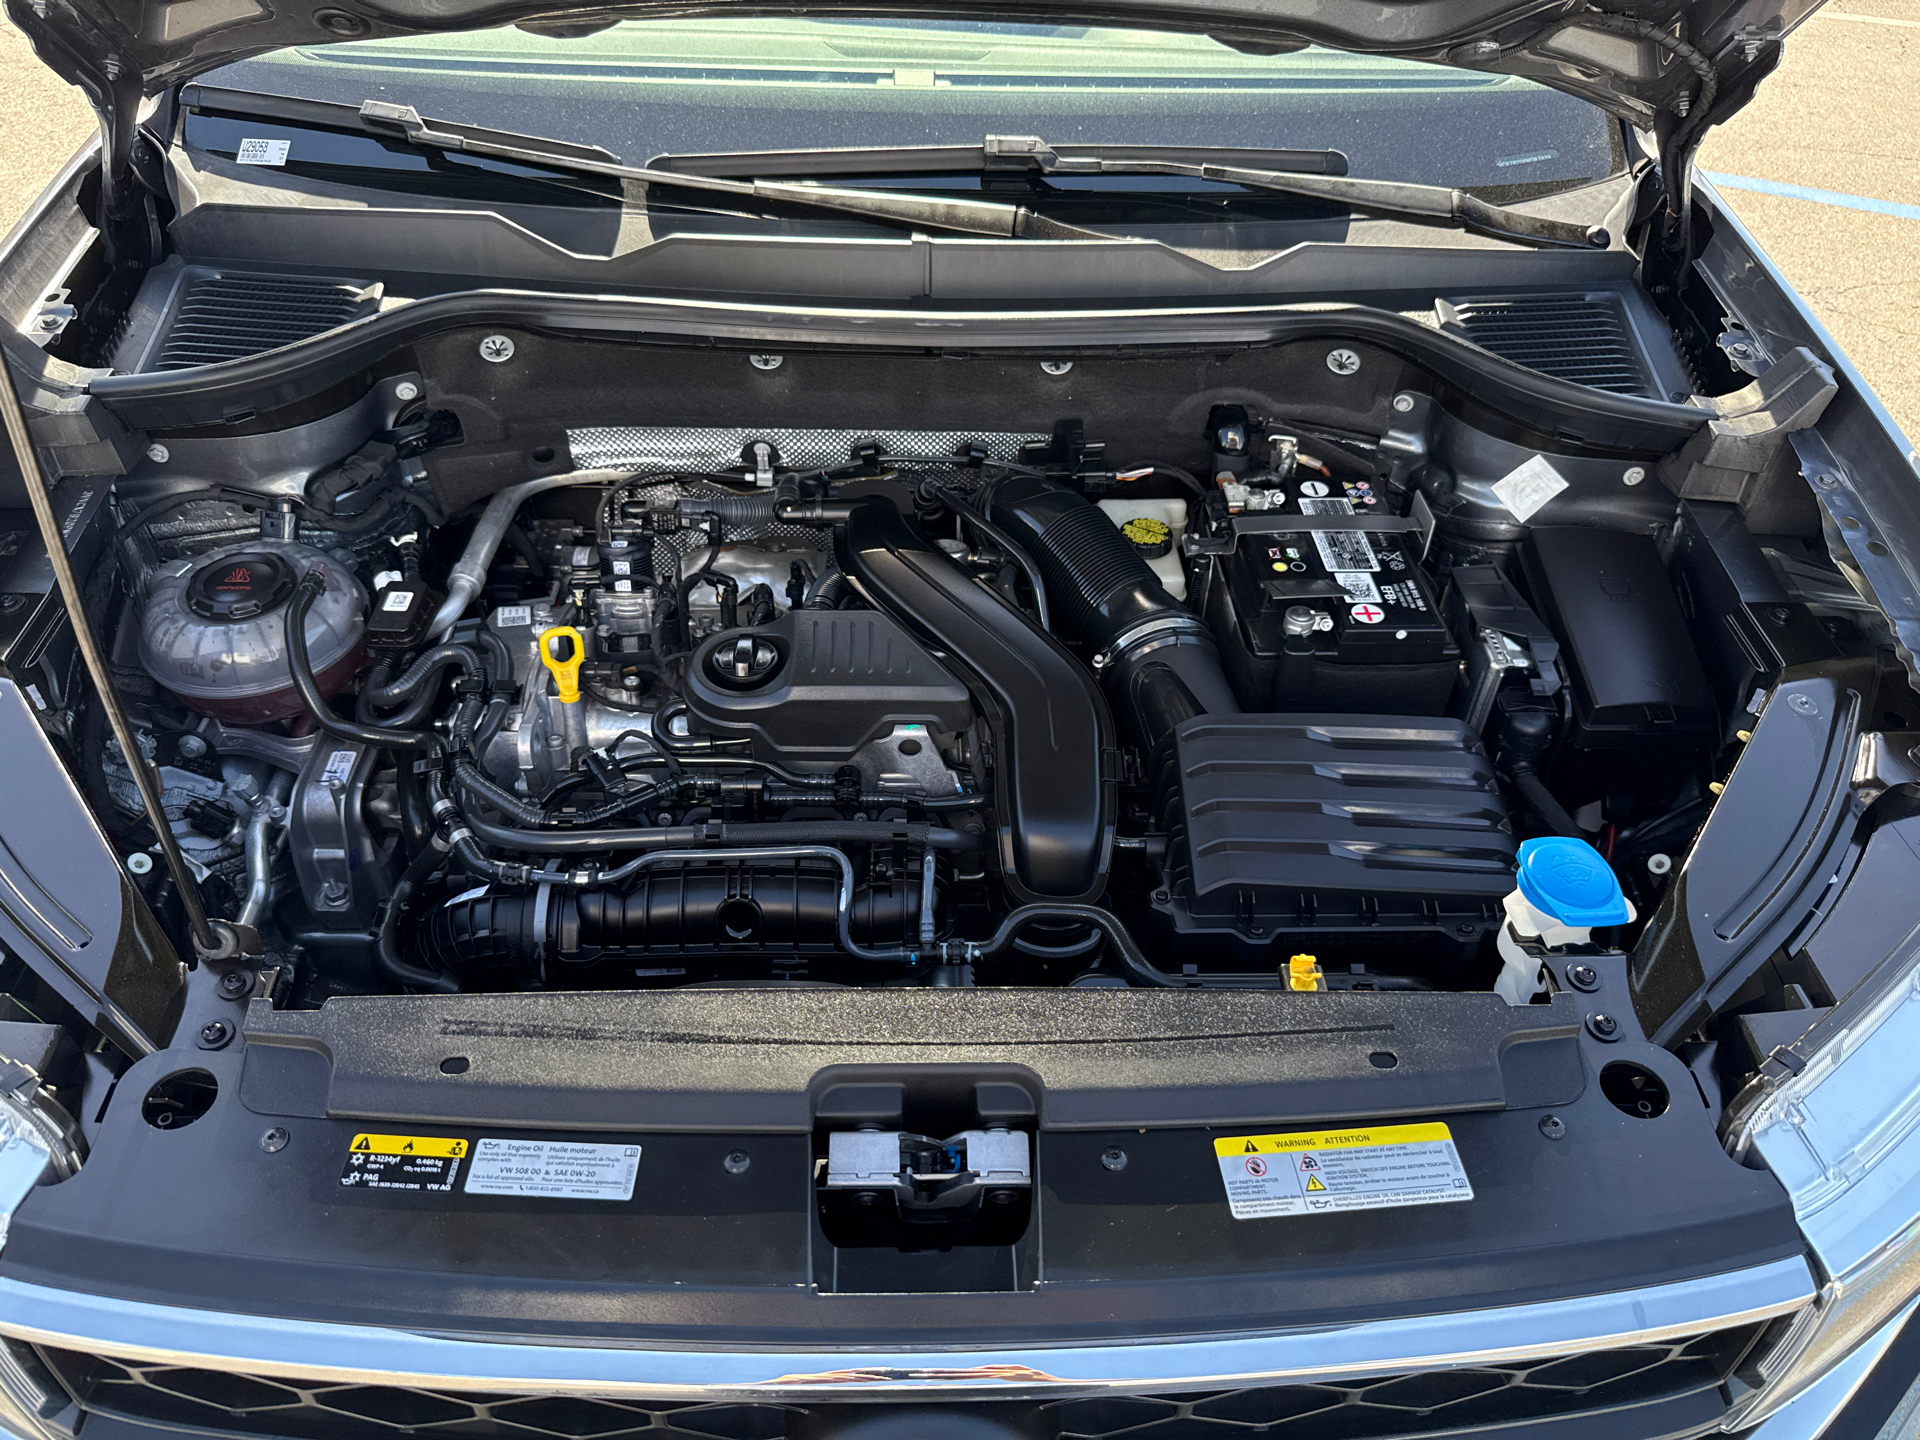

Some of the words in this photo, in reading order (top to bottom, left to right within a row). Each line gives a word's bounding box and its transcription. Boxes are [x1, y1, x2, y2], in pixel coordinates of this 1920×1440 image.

[242, 140, 269, 153] U29058
[1380, 585, 1397, 605] EFB+
[1274, 1138, 1315, 1147] WARNING
[1324, 1134, 1370, 1144] ATTENTION
[507, 1144, 531, 1152] Engine
[369, 1154, 400, 1164] R-1234yf
[1239, 1201, 1275, 1209] compartiment
[1334, 1198, 1364, 1208] Remplissage
